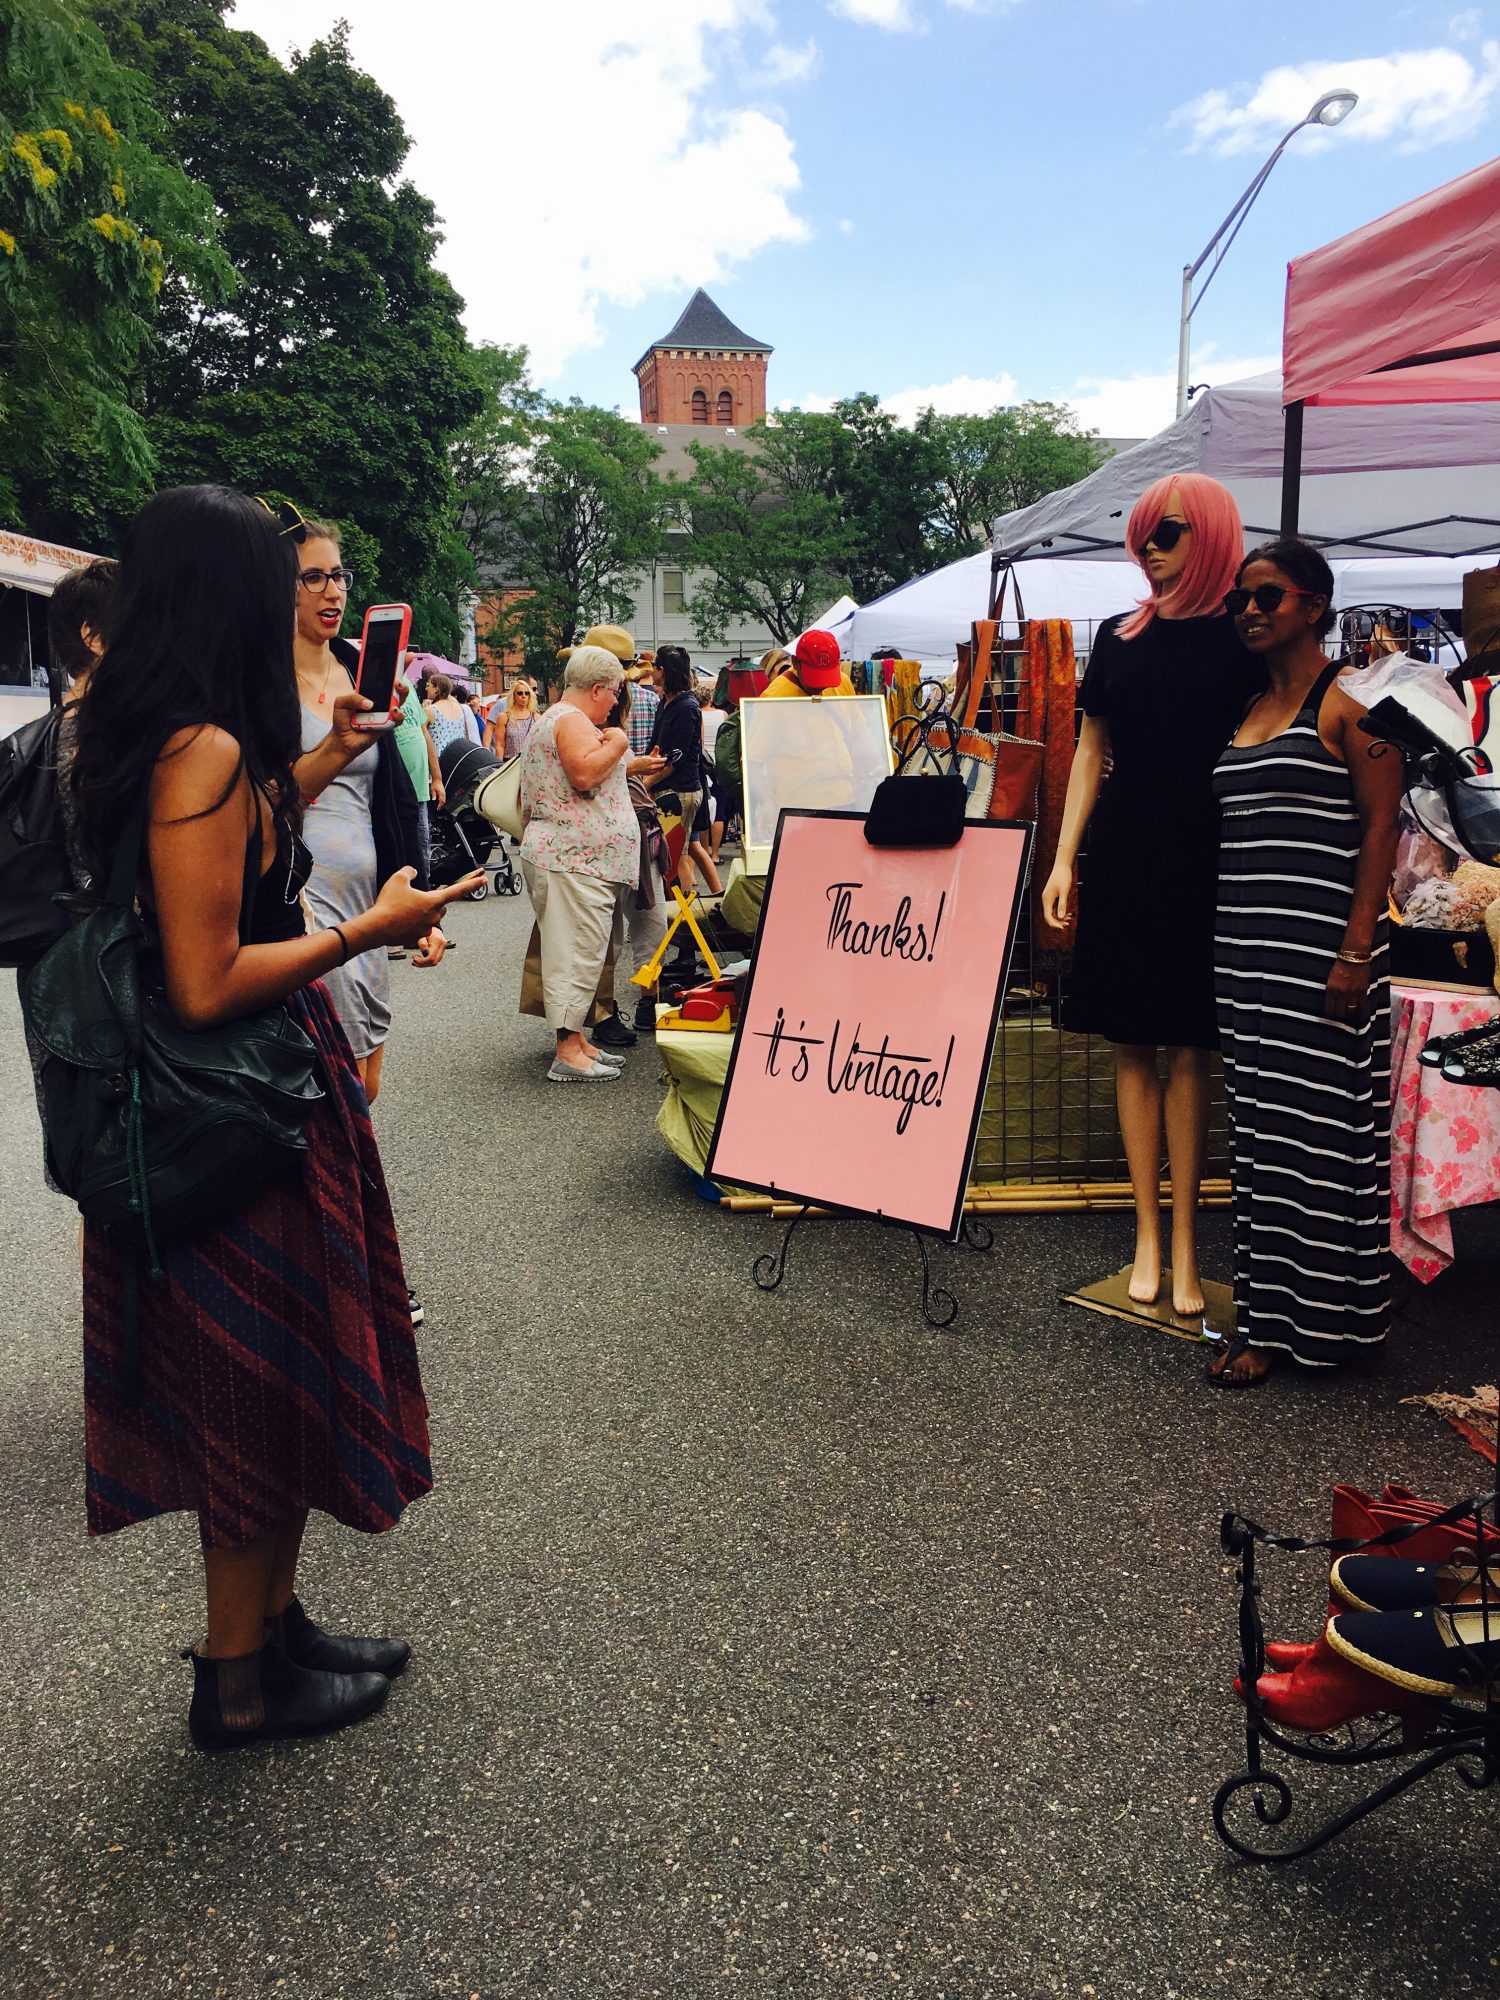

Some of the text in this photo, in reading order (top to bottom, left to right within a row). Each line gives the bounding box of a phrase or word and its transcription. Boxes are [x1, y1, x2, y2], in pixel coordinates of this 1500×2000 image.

[826, 883, 946, 962] Thanks!
[752, 1007, 955, 1135] it's Vintage!
